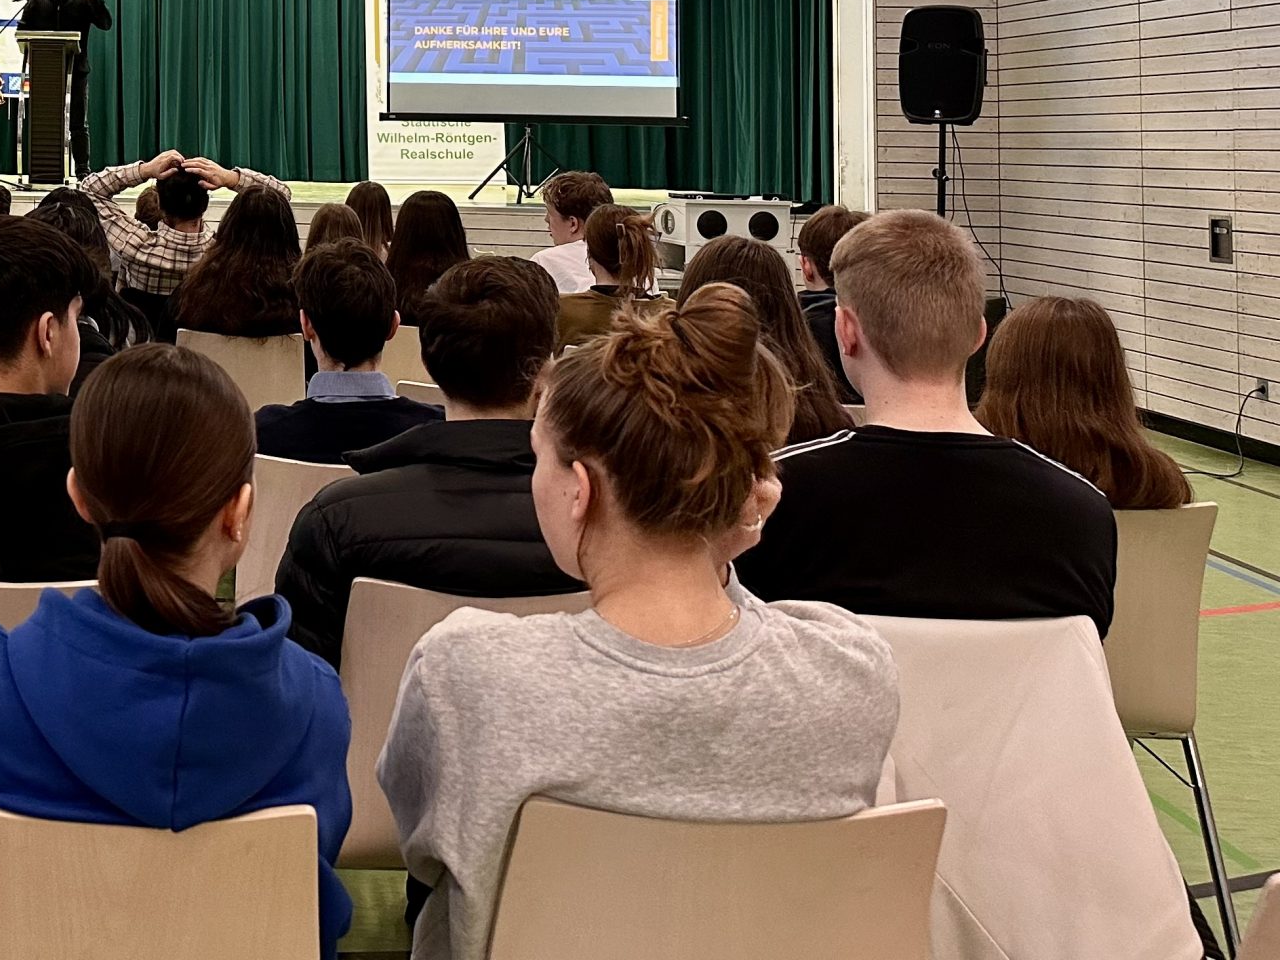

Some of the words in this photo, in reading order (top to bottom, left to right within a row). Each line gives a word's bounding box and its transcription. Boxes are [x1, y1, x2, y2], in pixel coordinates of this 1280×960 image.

[415, 26, 453, 35] DANKE
[456, 25, 478, 35] FÜR
[481, 27, 508, 36] IHRE
[511, 27, 536, 36] UND
[539, 27, 570, 37] EURE
[414, 40, 521, 50] AUFMERKSAMKEIT!
[377, 133, 497, 145] Wilhelm-Röntgen-
[400, 149, 474, 159] Realschule
